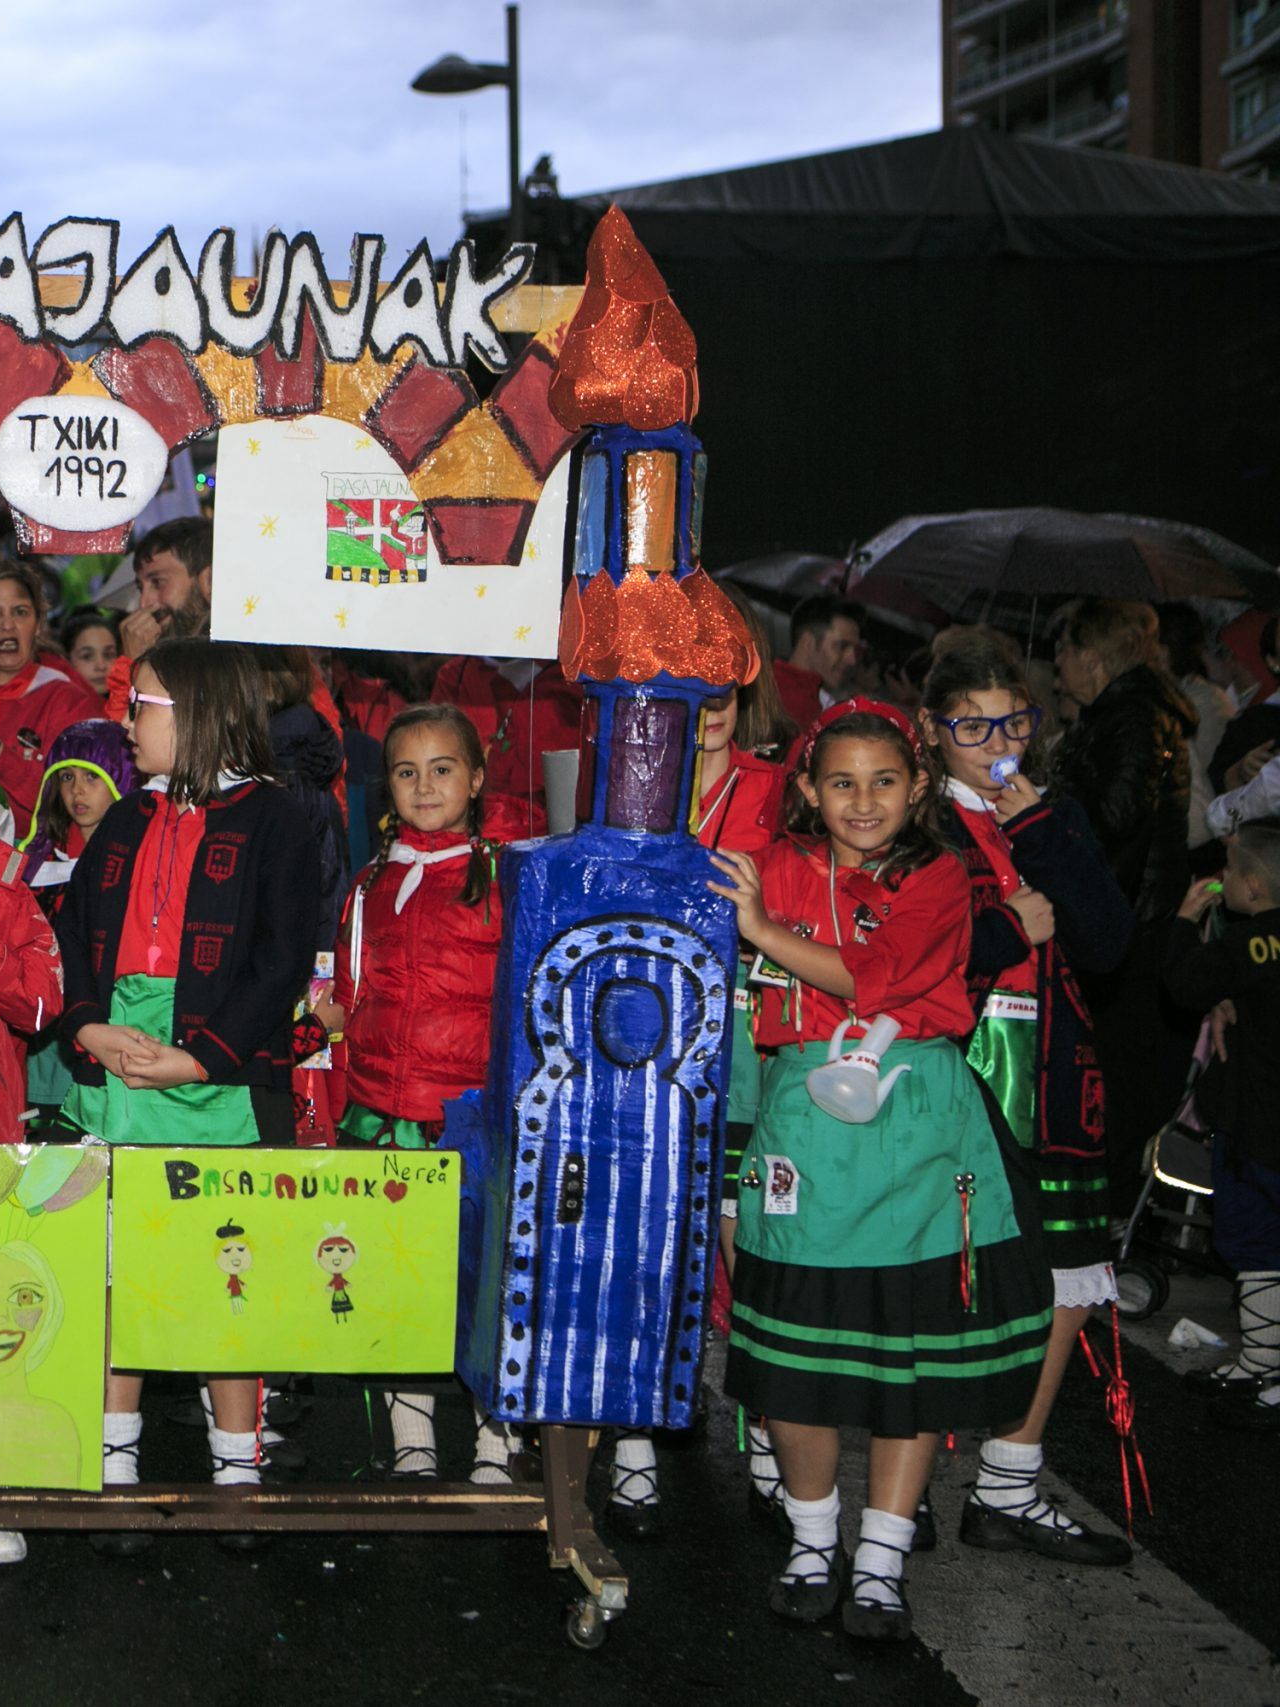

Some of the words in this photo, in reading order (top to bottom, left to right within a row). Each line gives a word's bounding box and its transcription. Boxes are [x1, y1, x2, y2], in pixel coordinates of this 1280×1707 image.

[18, 413, 119, 452] TXIKI
[45, 455, 128, 501] 1992
[164, 1160, 378, 1201] BASAJAUNAK
[383, 1154, 447, 1184] Nerea
